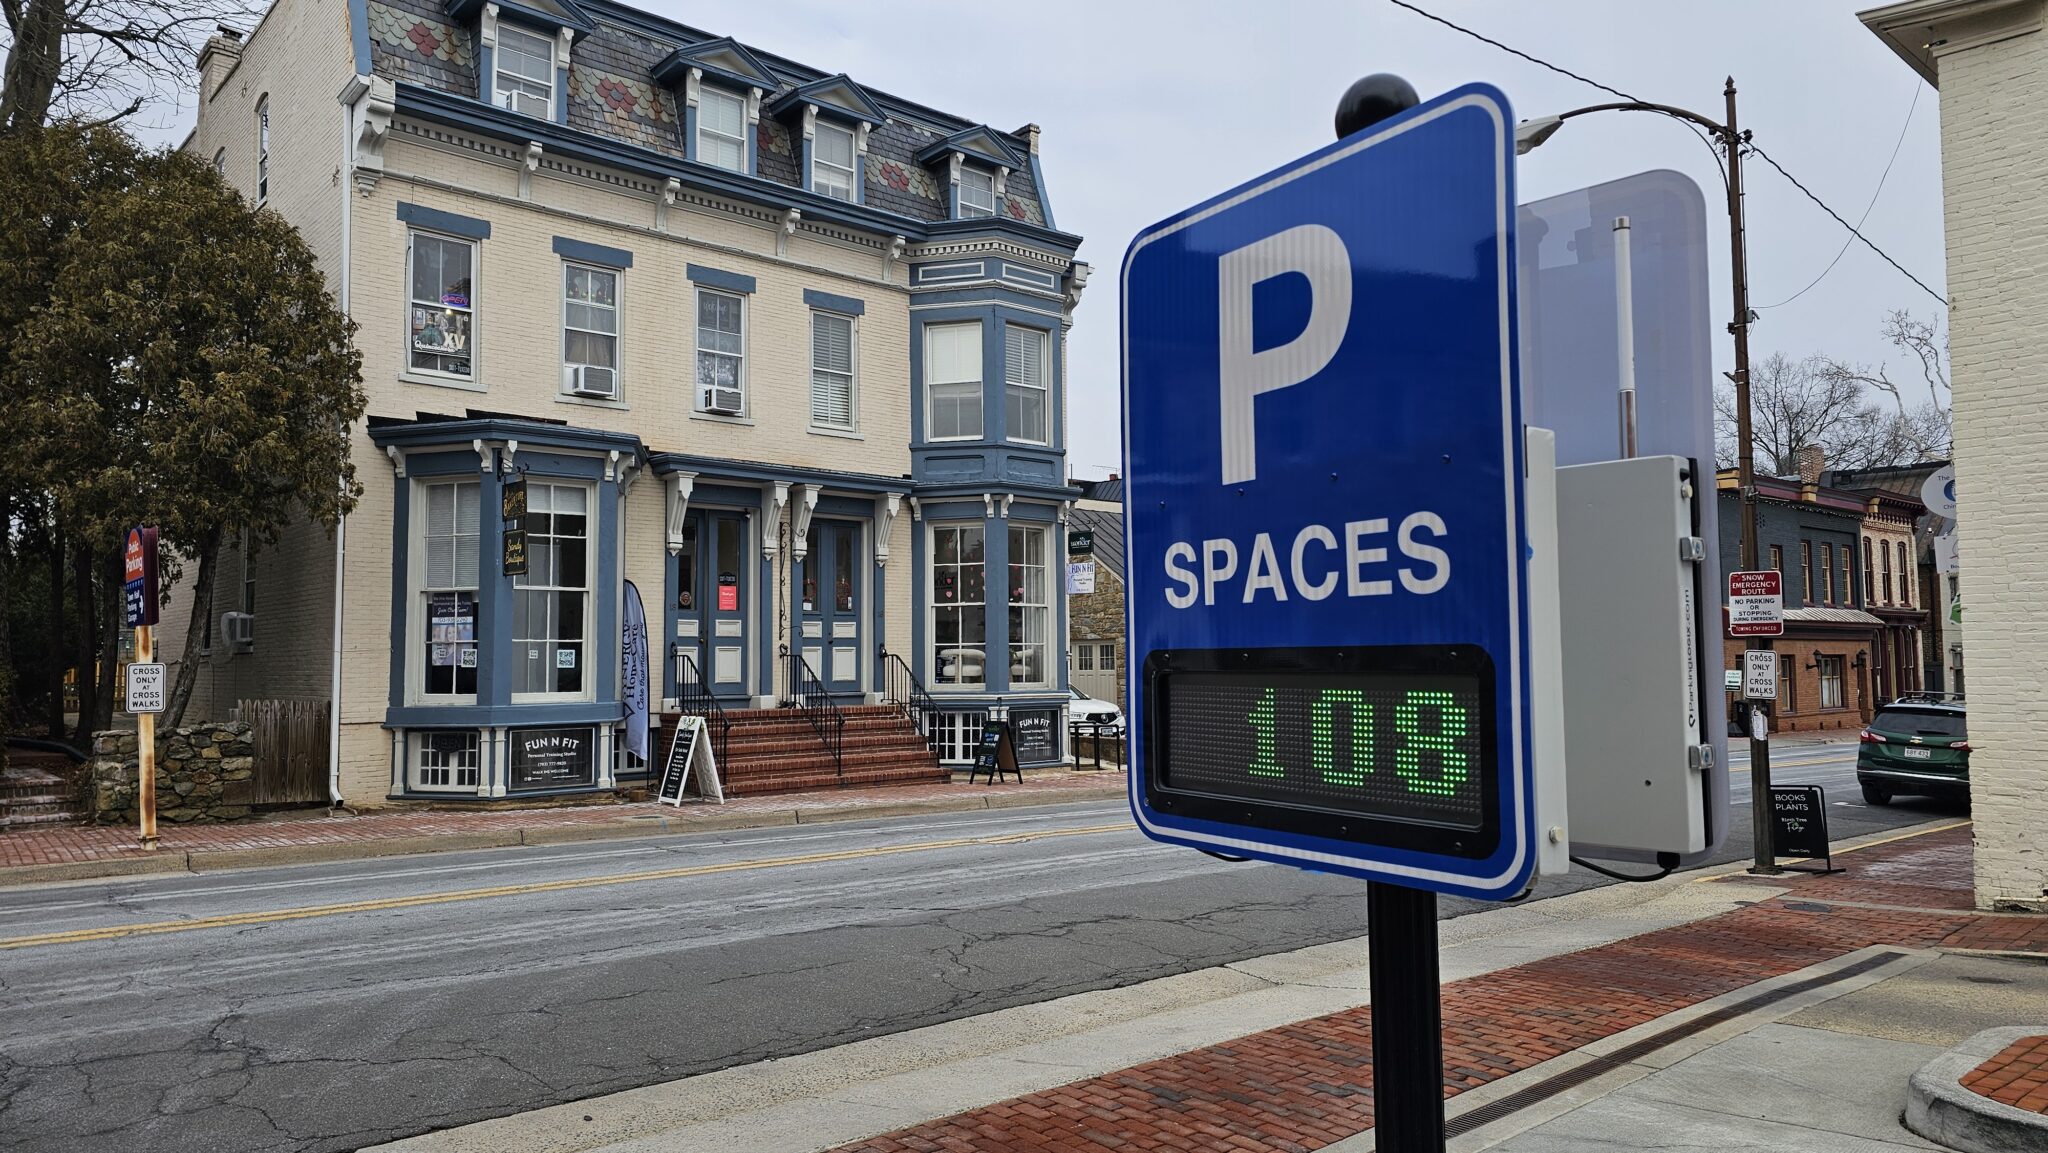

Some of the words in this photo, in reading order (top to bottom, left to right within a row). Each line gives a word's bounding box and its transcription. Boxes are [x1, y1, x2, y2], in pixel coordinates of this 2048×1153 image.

[441, 294, 469, 306] OPEN
[443, 331, 465, 350] XV
[1219, 224, 1353, 486] P
[128, 541, 138, 554] Public
[508, 538, 522, 553] Sandy
[126, 556, 142, 573] Parking
[1072, 564, 1081, 573] FUN
[1164, 511, 1451, 609] SPACES
[1685, 590, 1694, 712] Parkinglogix.com
[627, 624, 638, 699] HomeCare
[132, 667, 160, 675] CROSS
[636, 687, 644, 711] Care
[1019, 718, 1032, 728] FUN
[1040, 718, 1050, 727] FIT
[524, 738, 548, 752] FUN
[552, 736, 560, 746] N
[562, 737, 580, 749] FIT
[1246, 687, 1466, 797] 108
